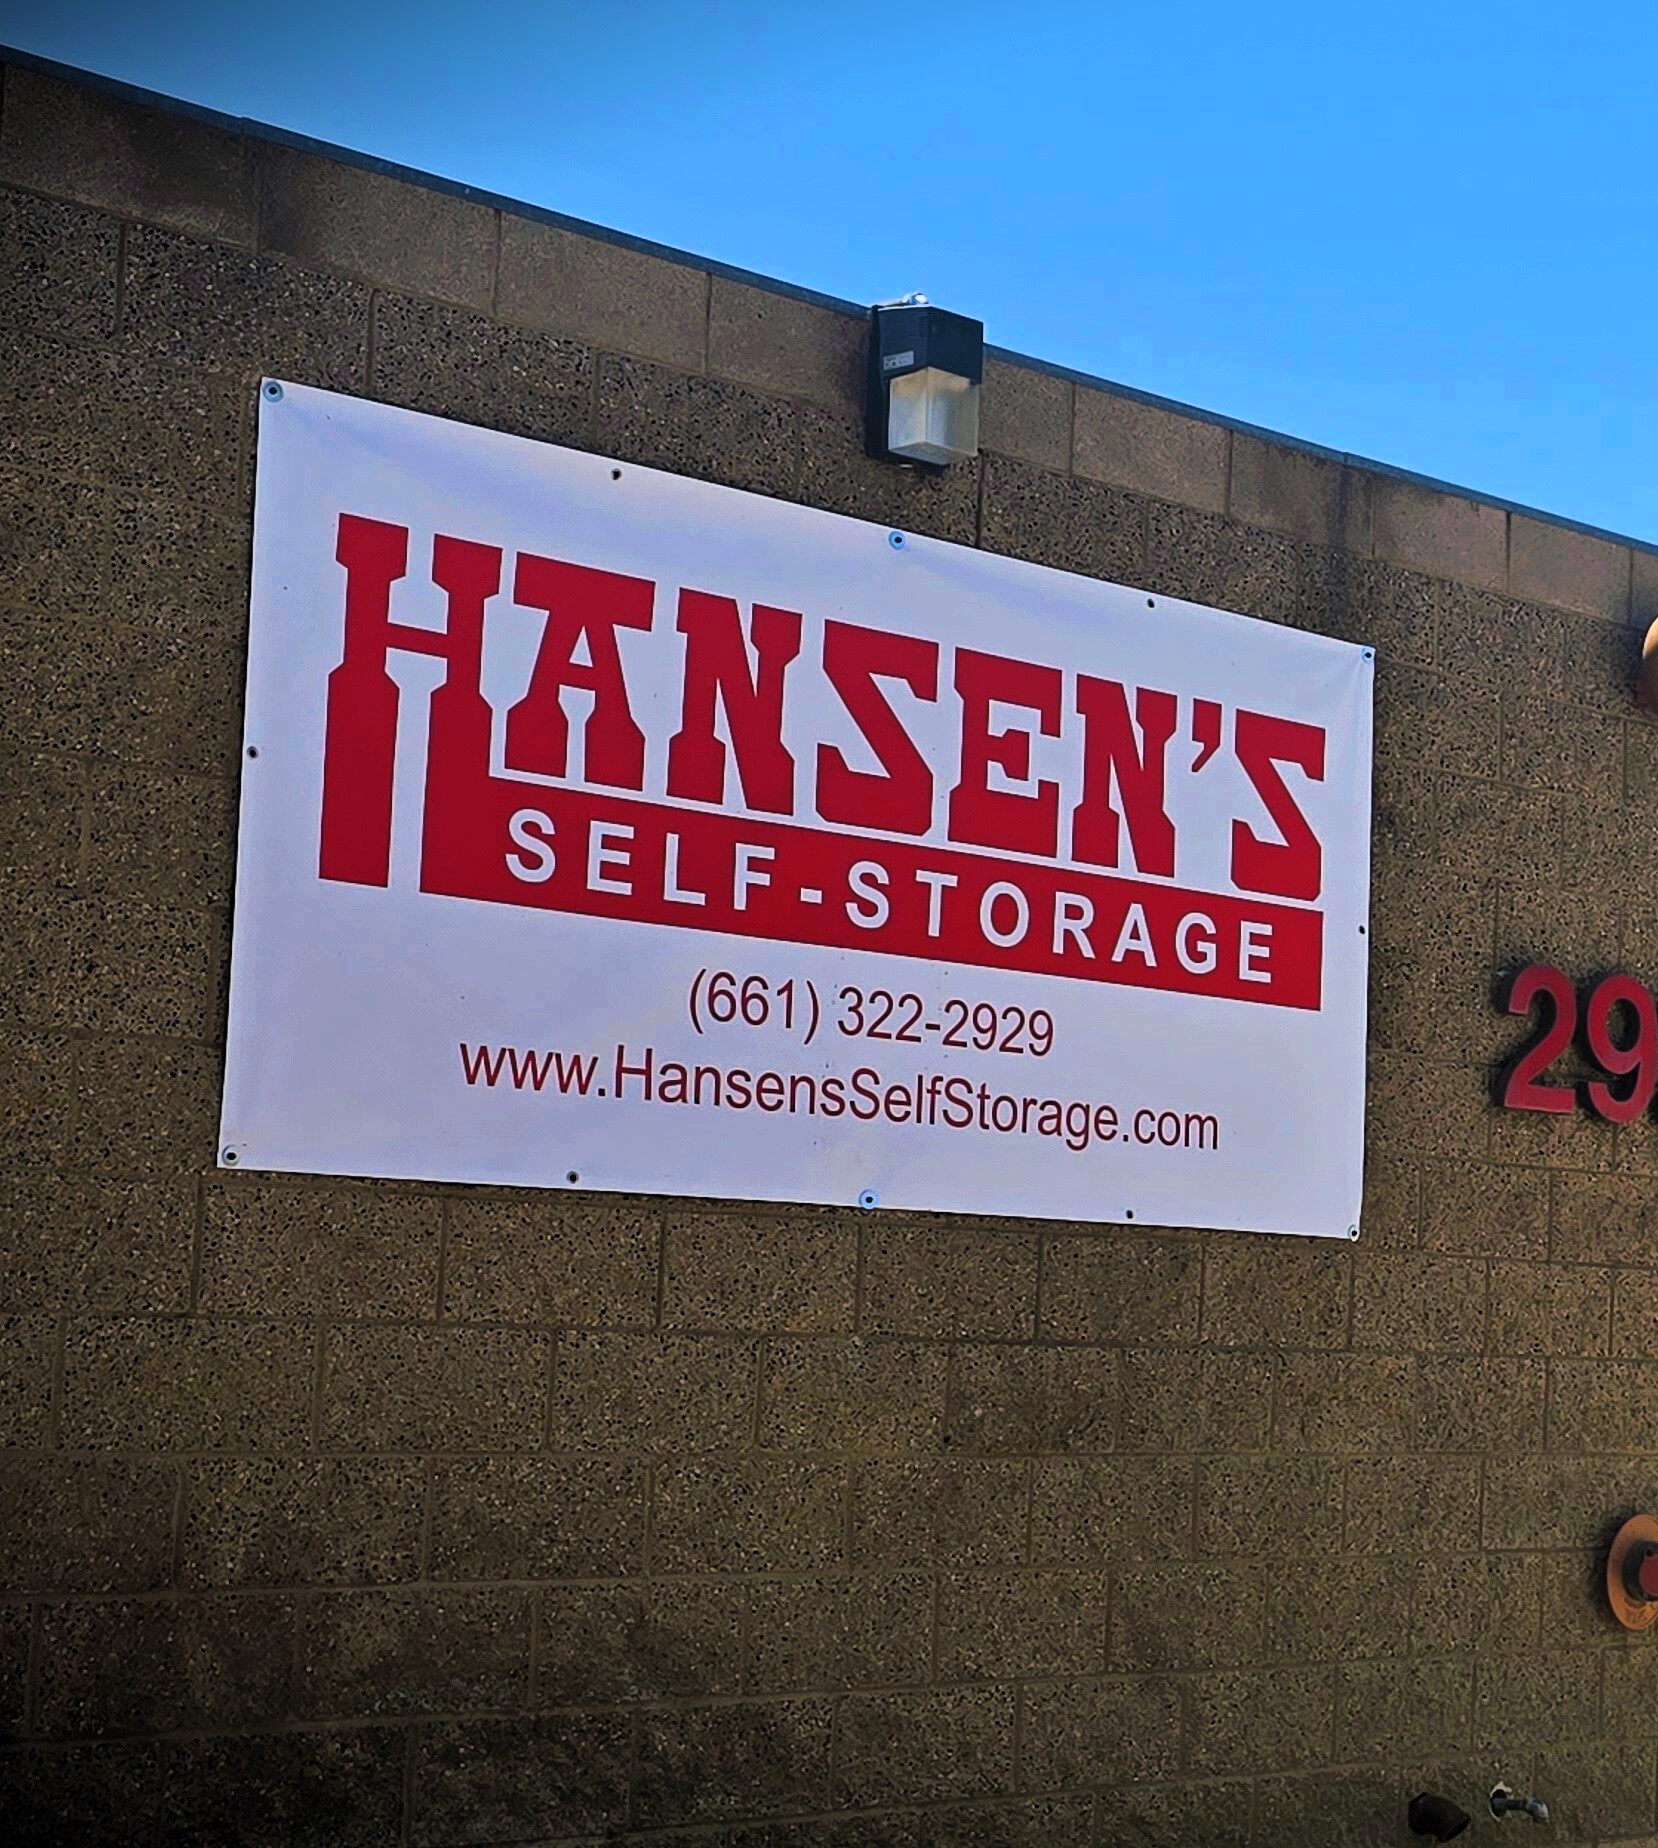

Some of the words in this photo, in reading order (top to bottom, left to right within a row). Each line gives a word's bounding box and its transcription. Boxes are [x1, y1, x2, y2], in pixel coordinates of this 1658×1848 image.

[319, 512, 1326, 903] HANSEN'S
[505, 808, 1274, 983] SELF-STORAGE
[689, 968, 820, 1046] (661)
[837, 986, 1054, 1057] 322-2929
[459, 1042, 1218, 1152] www.HansensSelfStorage.com
